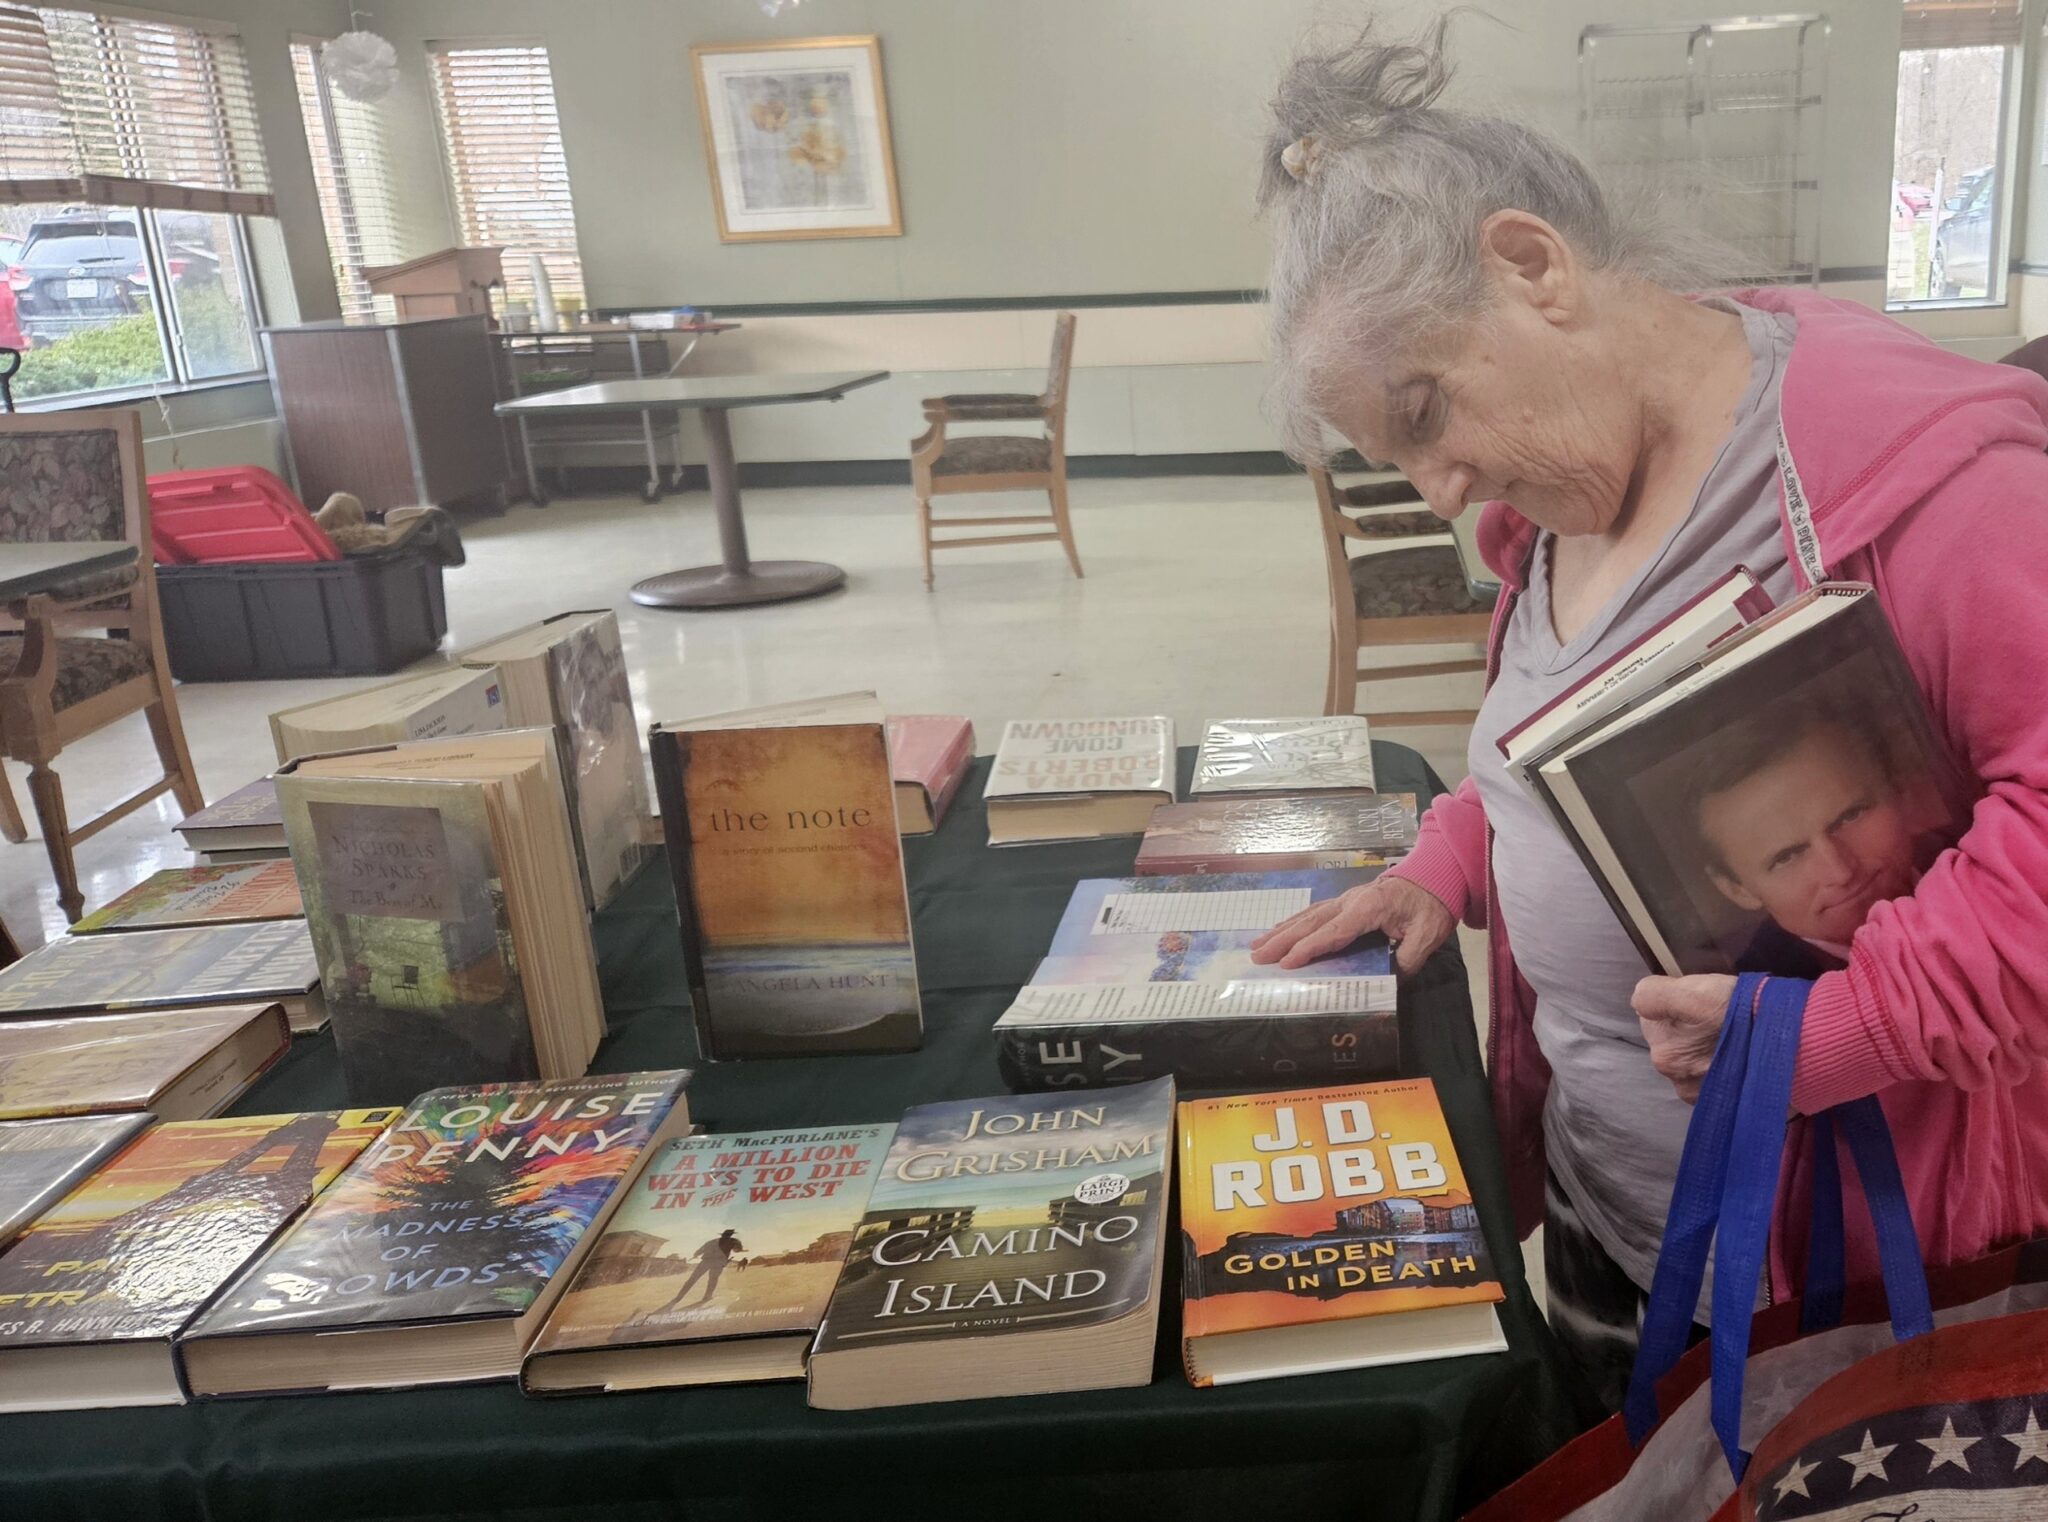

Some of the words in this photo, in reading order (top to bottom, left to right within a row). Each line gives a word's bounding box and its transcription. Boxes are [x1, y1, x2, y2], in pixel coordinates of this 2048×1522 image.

[1046, 736, 1124, 754] COME
[997, 754, 1160, 776] ROBERTS
[1027, 771, 1133, 790] NORA
[709, 808, 769, 832] the
[787, 806, 873, 830] note
[331, 836, 435, 859] NICHOLAS
[351, 859, 427, 880] SPARKS
[735, 975, 821, 994] ANGELA
[829, 973, 890, 989] HUNT
[626, 1078, 678, 1087] AUTHOR
[1282, 1096, 1314, 1105] Times
[1317, 1089, 1380, 1101] Bestselling
[1382, 1085, 1420, 1094] Author
[396, 1092, 664, 1133] LOUISE
[960, 1106, 1107, 1143] JOHN
[369, 1127, 632, 1170] PENNY
[669, 1138, 725, 1152] SETH
[671, 1154, 698, 1172] A
[710, 1143, 862, 1169] MILLION
[897, 1133, 1155, 1182] GRISHAM
[647, 1170, 741, 1191] WAYS
[752, 1166, 795, 1184] TO
[807, 1160, 872, 1179] DIE
[1211, 1141, 1448, 1211] ROBB
[429, 1200, 473, 1212] THE
[650, 1192, 696, 1210] IN
[701, 1188, 738, 1208] THE
[749, 1180, 845, 1203] WEST
[331, 1214, 523, 1241] MADNESS
[871, 1215, 1139, 1267] CAMINO
[380, 1243, 440, 1262] OF
[1224, 1239, 1396, 1276] GOLDEN
[310, 1263, 506, 1296] OWDS
[1286, 1271, 1320, 1292] IN
[1337, 1255, 1477, 1288] DEATH
[873, 1269, 1107, 1318] ISLAND
[973, 1318, 1012, 1327] NOVEL
